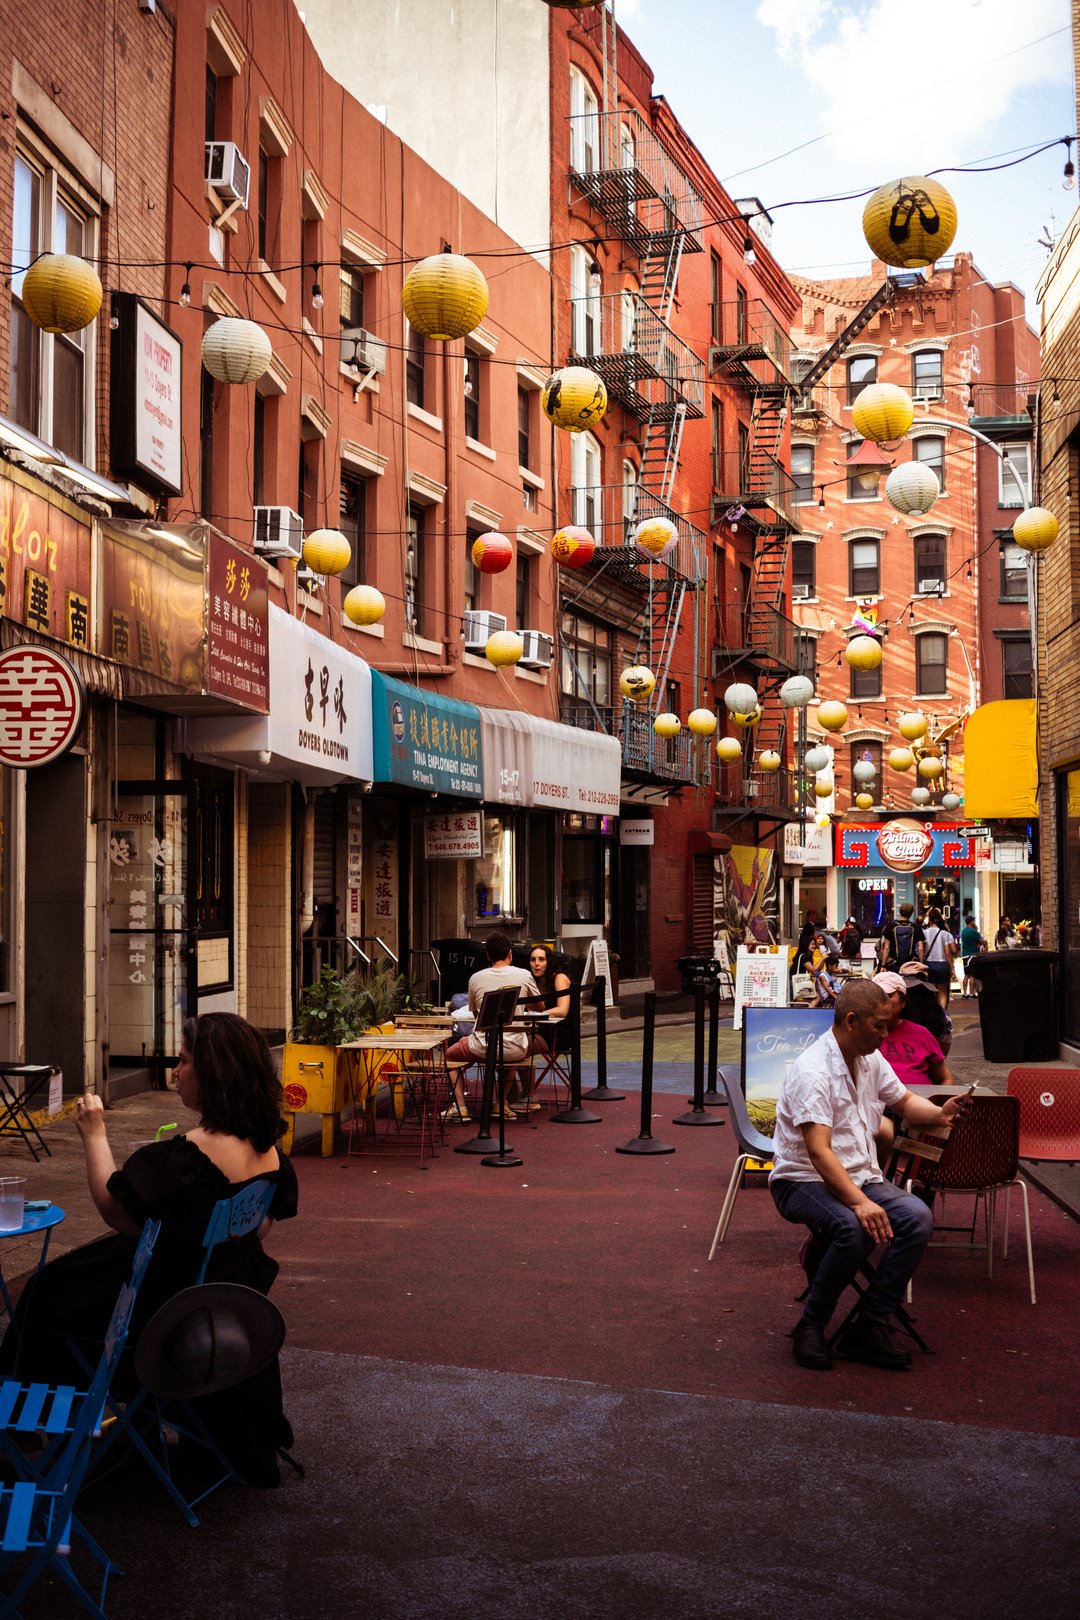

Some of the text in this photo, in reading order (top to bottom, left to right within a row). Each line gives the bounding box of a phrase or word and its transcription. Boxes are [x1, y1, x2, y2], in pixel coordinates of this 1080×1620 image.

[553, 535, 570, 556] 福
[304, 657, 347, 735] 古早味
[298, 728, 350, 762] DOYERS OLDTOWN
[413, 749, 427, 767] TINA
[428, 753, 459, 774] EMPLOYMENT
[460, 762, 479, 778] AGENCY
[500, 768, 520, 786] 15-17
[533, 781, 539, 795] 17
[540, 782, 561, 799] DOYERS
[562, 786, 570, 800] ST.
[578, 788, 587, 801] Tel:
[880, 829, 921, 846] Anime
[858, 878, 889, 892] OPEN
[448, 952, 476, 968] 15 17
[757, 1034, 790, 1053] Tea
